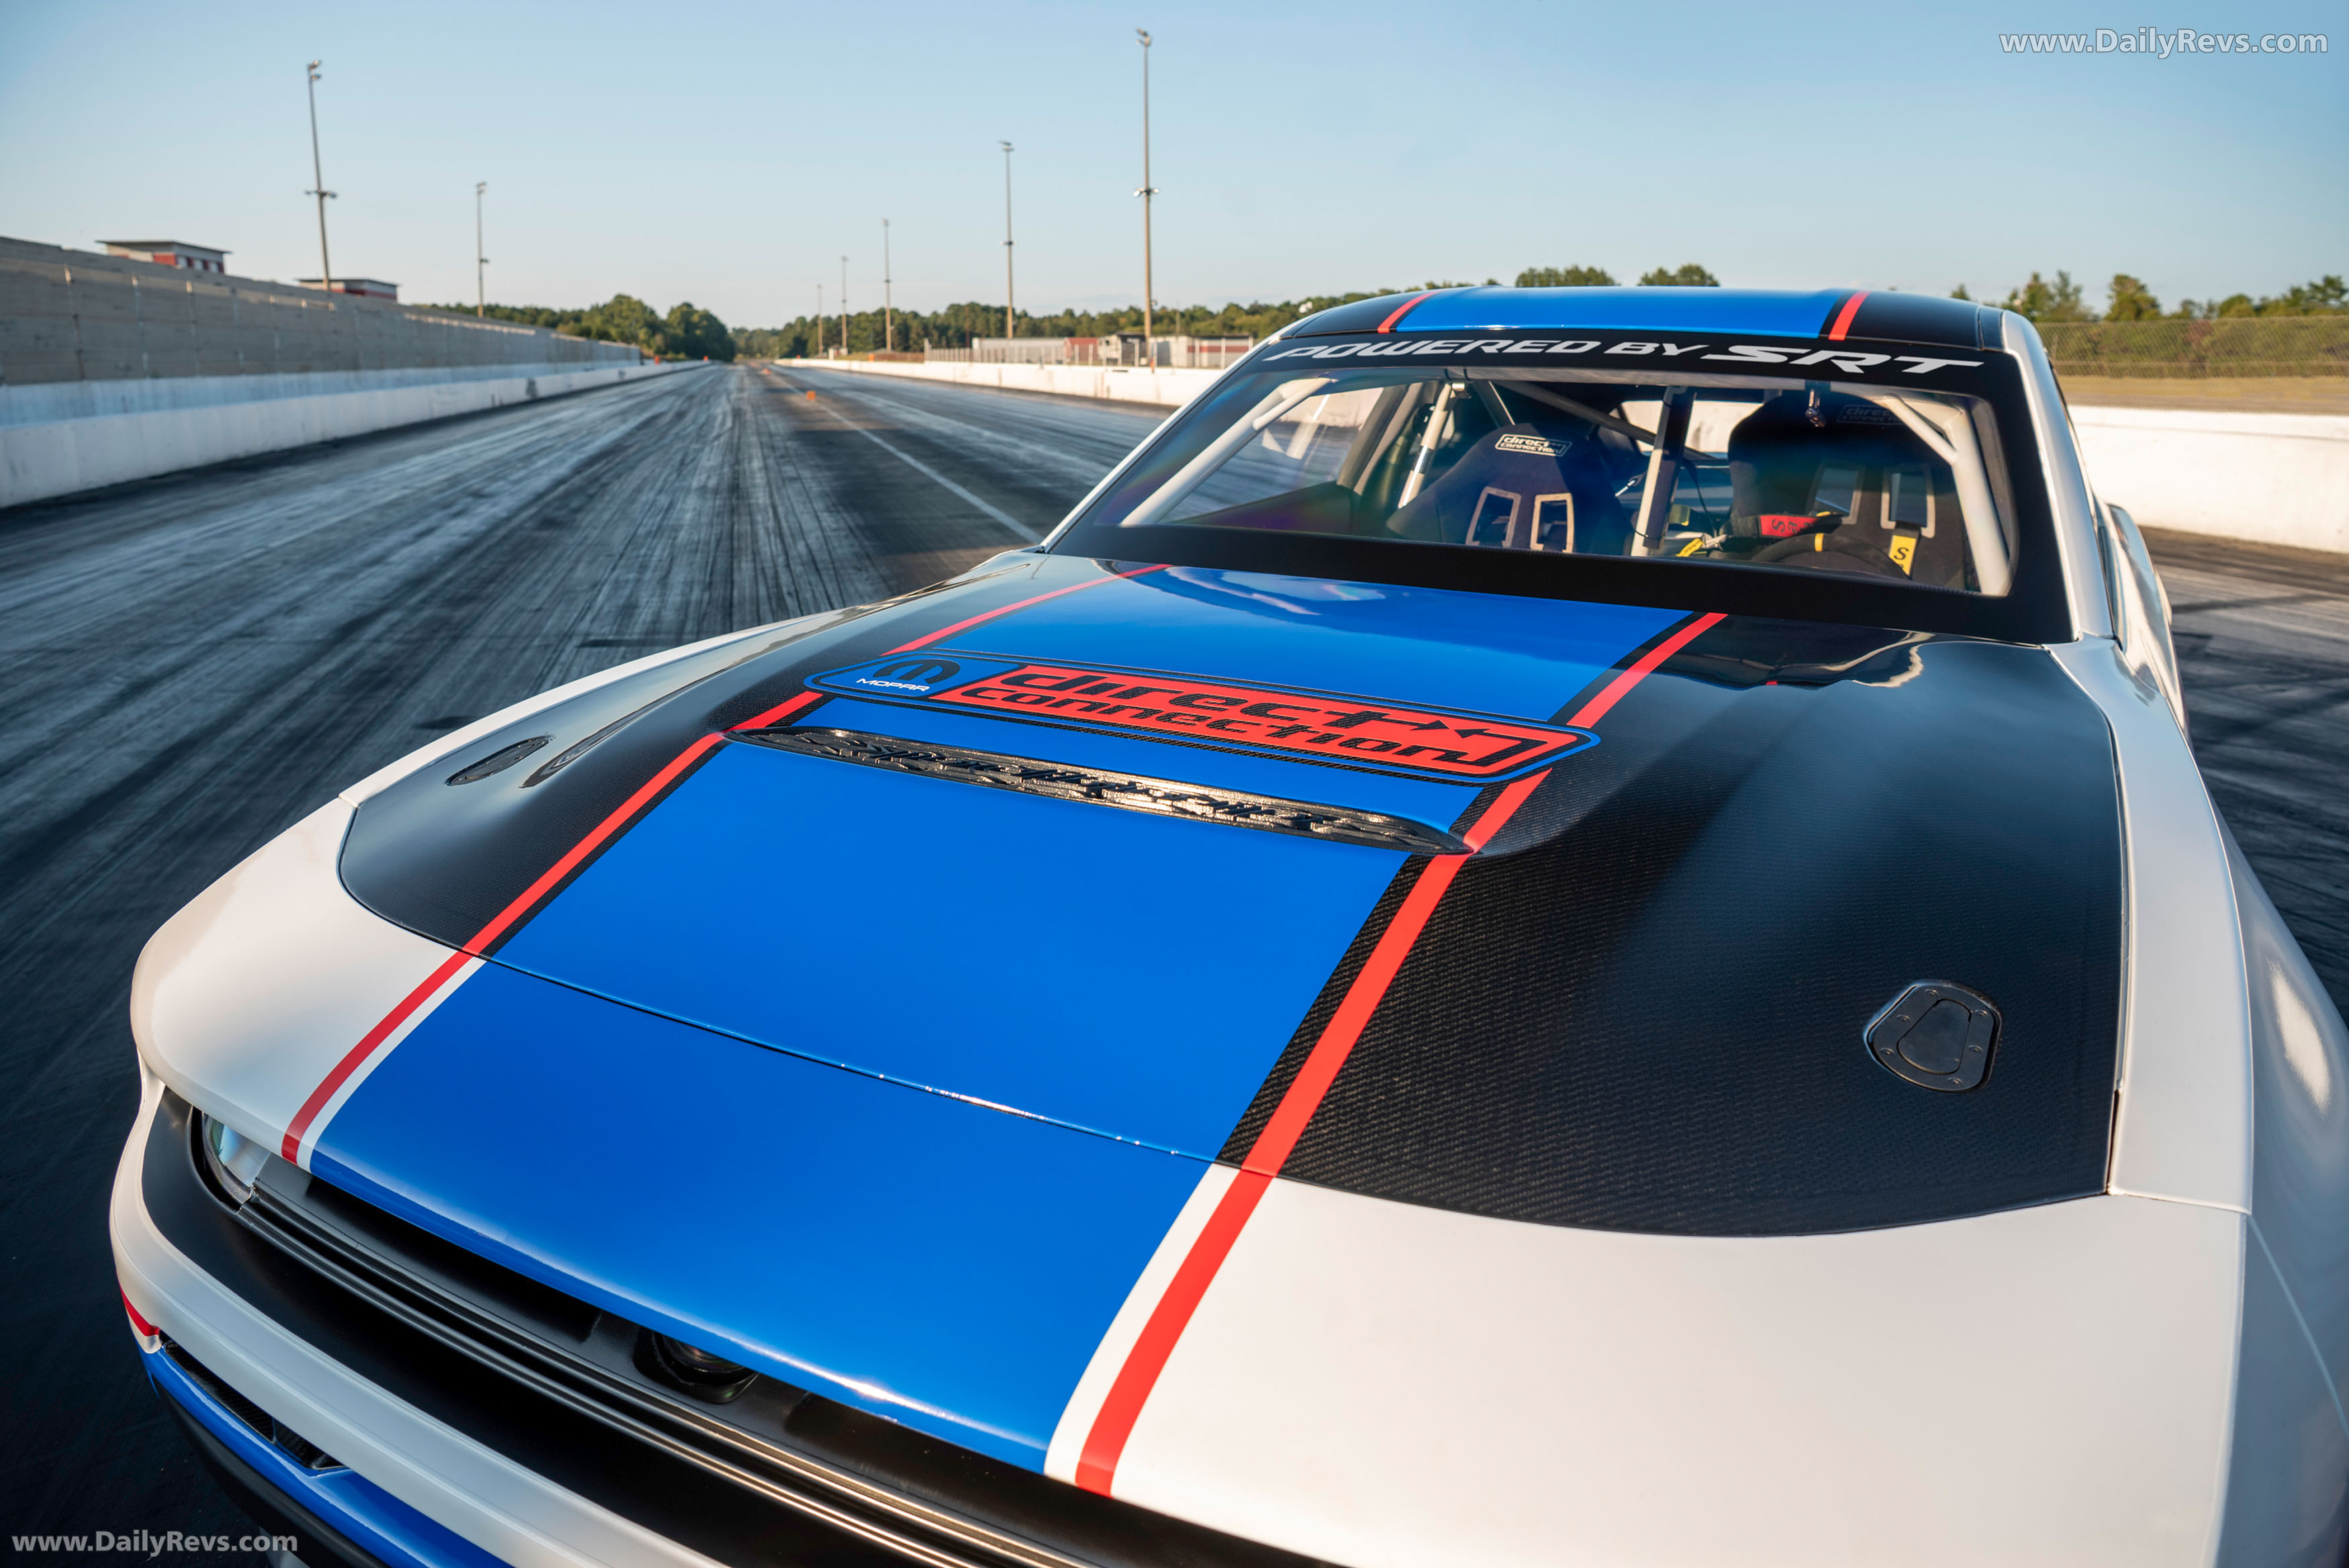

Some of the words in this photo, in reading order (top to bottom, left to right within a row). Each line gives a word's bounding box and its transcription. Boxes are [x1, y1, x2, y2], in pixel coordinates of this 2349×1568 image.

[1262, 339, 1602, 361] POWERED
[1604, 341, 1710, 356] BY
[1700, 344, 1984, 374] SRT
[855, 677, 930, 692] MOPAR
[1001, 673, 1391, 729] direct
[961, 686, 1480, 767] connection
